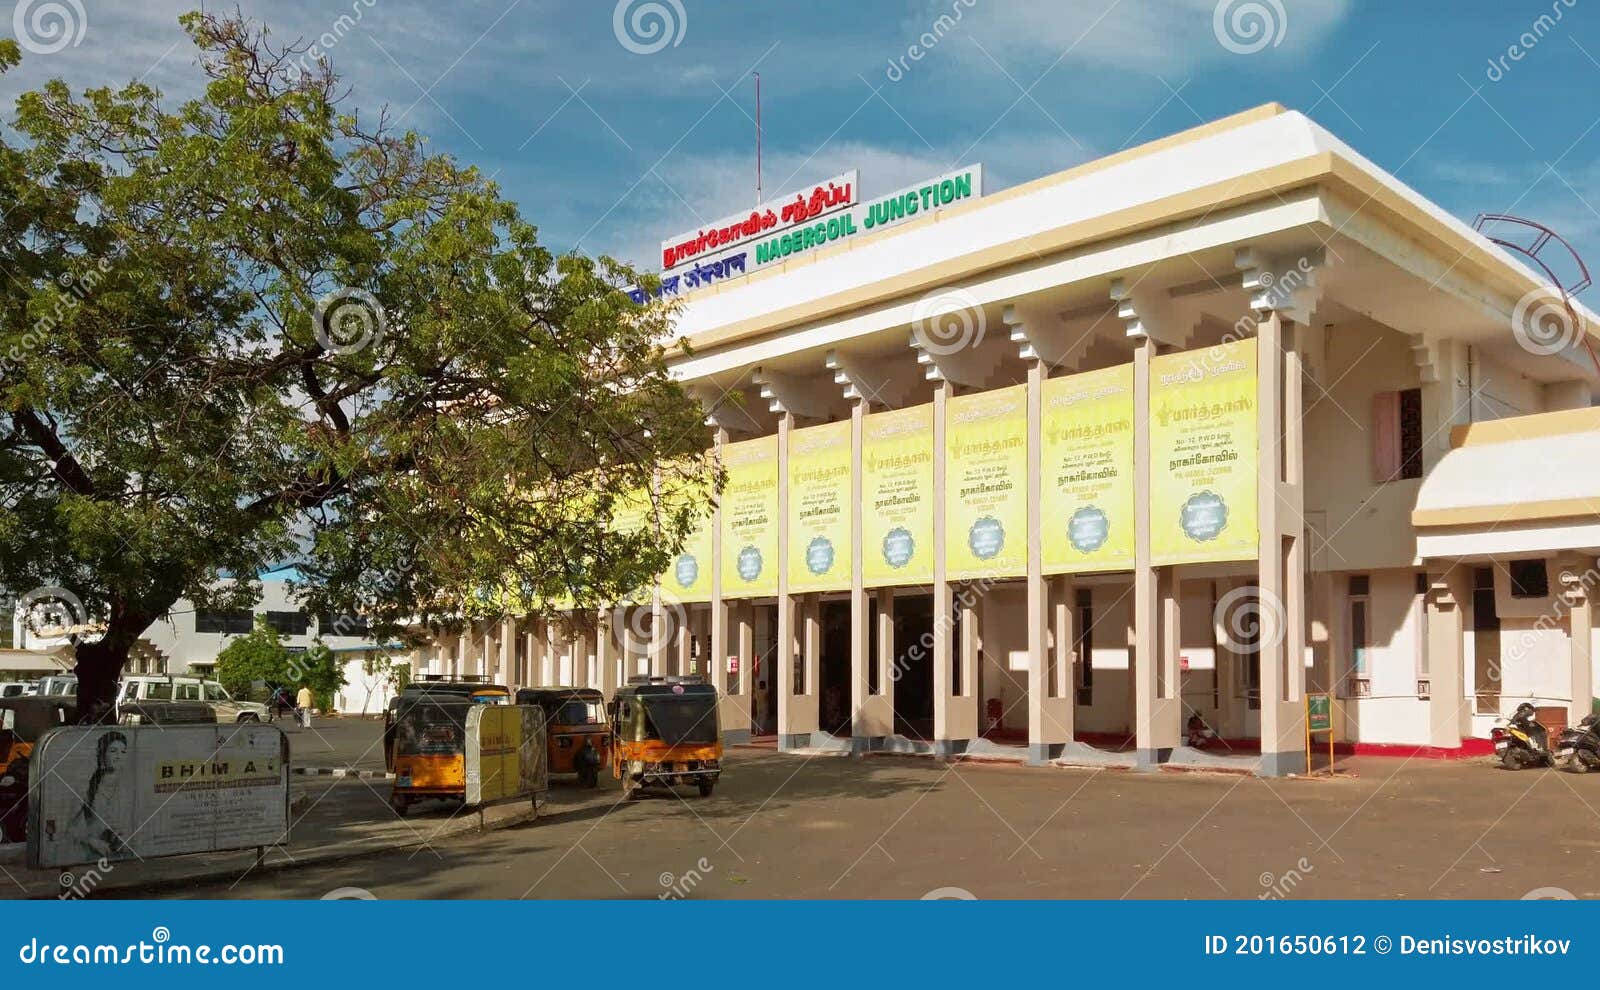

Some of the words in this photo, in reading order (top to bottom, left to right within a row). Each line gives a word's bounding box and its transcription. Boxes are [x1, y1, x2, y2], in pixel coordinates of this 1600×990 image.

[663, 210, 778, 268] நாகர்கோவில்
[781, 182, 852, 222] சந்திப்பு
[756, 213, 857, 265] NAGERCOIL
[864, 172, 971, 230] JUNCTION
[683, 252, 747, 288] जंक्शन
[1169, 449, 1239, 471] நாகர்கோவில்
